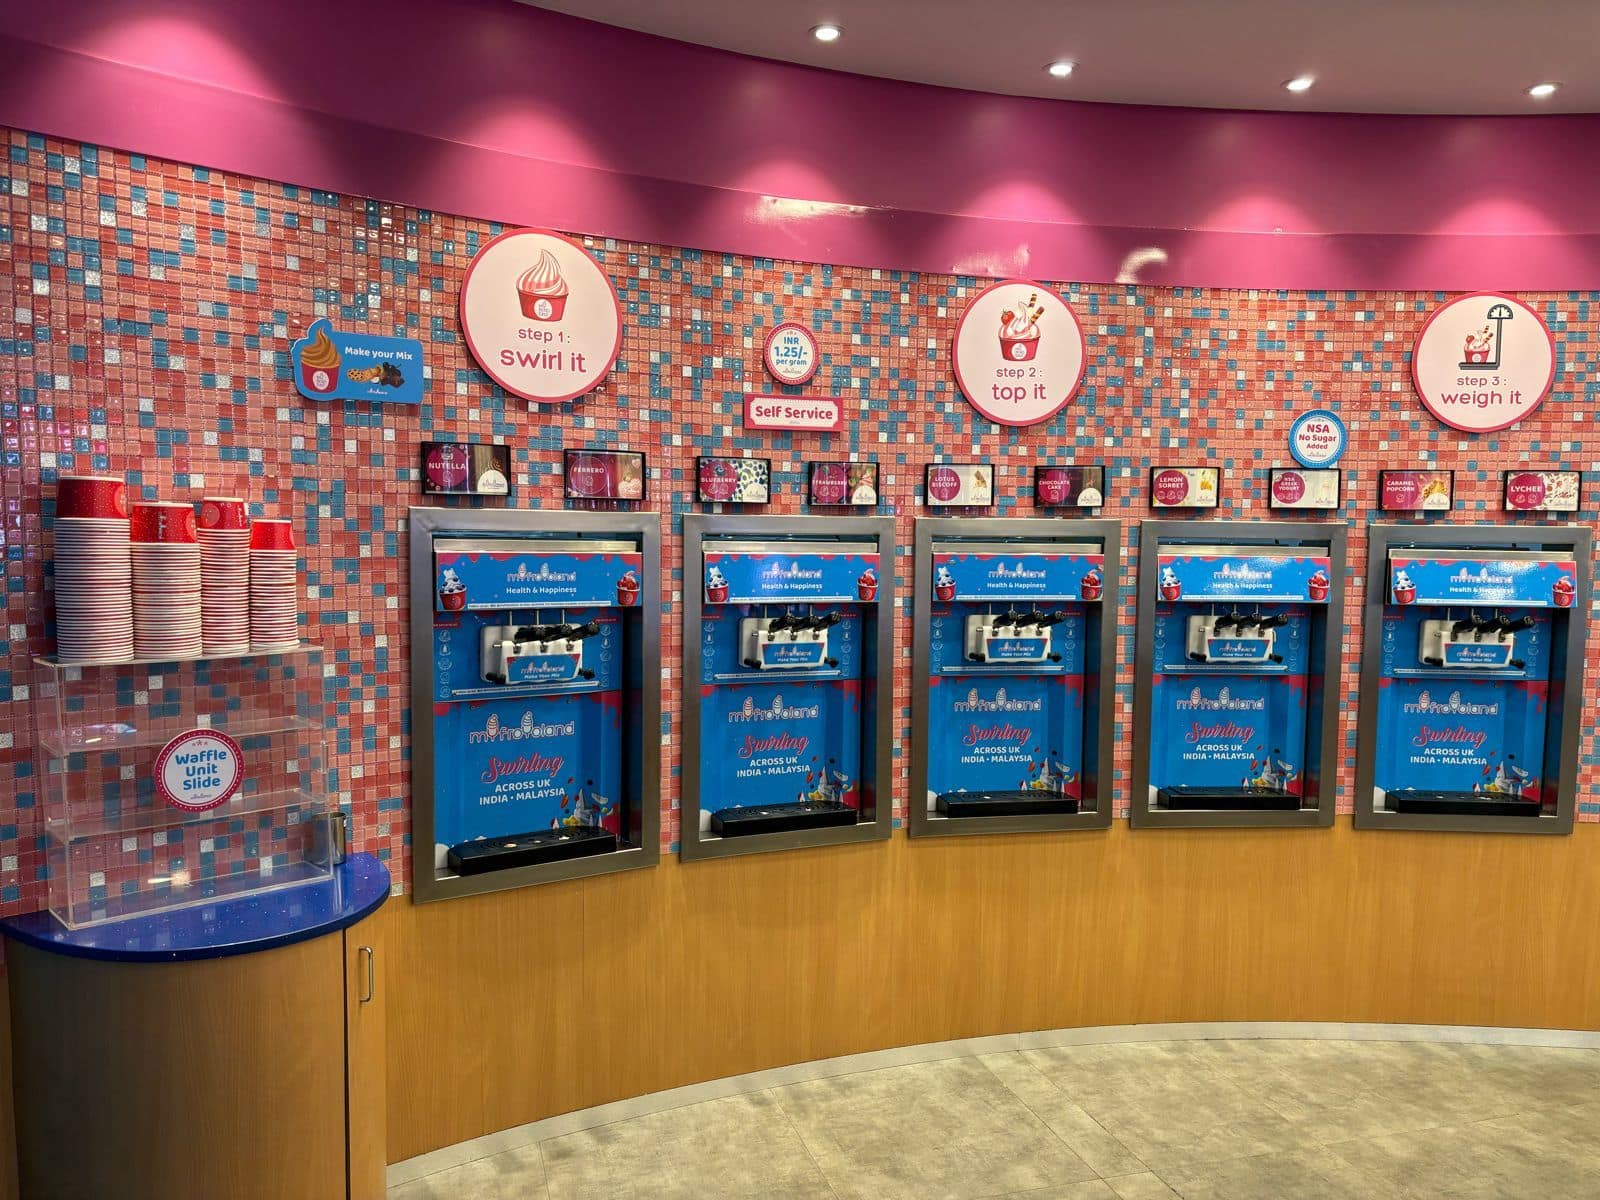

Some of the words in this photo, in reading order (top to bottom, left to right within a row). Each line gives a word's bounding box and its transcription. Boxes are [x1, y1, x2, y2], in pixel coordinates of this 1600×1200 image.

[518, 327, 553, 344] step
[784, 337, 799, 345] INR
[344, 346, 370, 357] Make
[371, 350, 394, 359] your
[396, 351, 413, 360] Mix
[774, 346, 808, 359] 1.25/-
[500, 349, 562, 370] swirl
[571, 352, 587, 373] it
[996, 367, 1025, 379] step
[1457, 376, 1488, 388] step
[992, 384, 1027, 404] top
[1034, 383, 1047, 400] it
[1441, 390, 1503, 408] weigh
[1510, 390, 1522, 405] it
[755, 406, 782, 418] Self
[785, 407, 833, 420] Service
[1307, 424, 1330, 433] NSA
[1312, 435, 1337, 443] Sugar
[428, 462, 466, 470] NUTELLA
[506, 586, 531, 594] Health
[539, 586, 577, 595] Happiness
[761, 582, 783, 590] Health
[790, 583, 823, 591] Happiness
[962, 722, 1032, 746] Swirling
[1185, 721, 1255, 744] Swirling
[1412, 725, 1488, 749] Swirling
[737, 731, 810, 759] Swirling
[1461, 748, 1474, 756] UK
[175, 749, 227, 765] Waffle
[750, 757, 784, 767] ACROSS
[785, 756, 798, 764] UK
[991, 754, 1033, 762] MALAYSIA
[1213, 752, 1255, 760] MALAYSIA
[1410, 756, 1436, 764] INDIA
[1442, 756, 1488, 765] MALAYSIA
[185, 763, 218, 777] Unit
[480, 752, 565, 784] Swirling
[736, 768, 761, 777] INDIA
[768, 764, 811, 775] MALAYSIA
[183, 776, 221, 790] Slide
[495, 782, 535, 793] ACROSS
[536, 779, 551, 787] UK
[479, 794, 509, 805] INDIA
[516, 787, 566, 800] MALAYSIA
